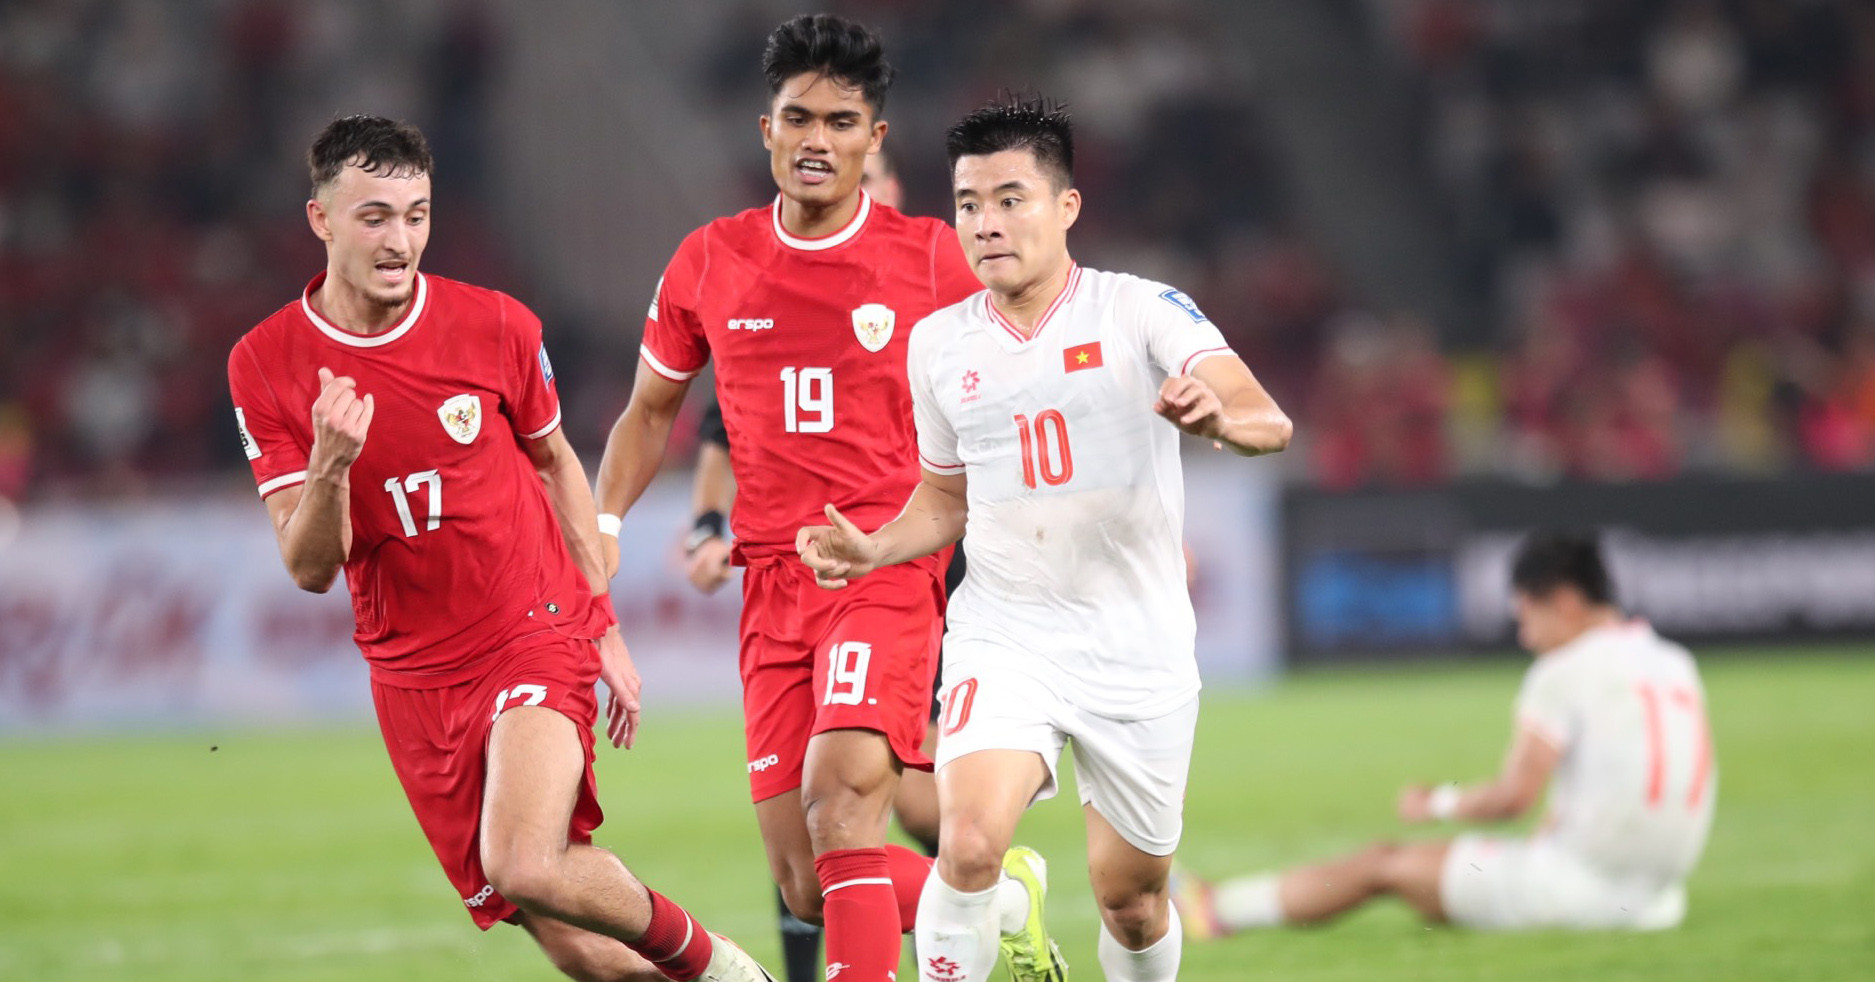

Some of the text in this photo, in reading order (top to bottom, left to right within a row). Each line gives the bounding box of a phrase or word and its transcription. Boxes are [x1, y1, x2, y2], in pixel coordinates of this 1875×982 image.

[727, 318, 774, 332] erspo
[780, 366, 834, 433] 19
[1013, 408, 1073, 489] 10
[384, 469, 442, 538] 17
[747, 754, 779, 773] rspo
[1637, 684, 1714, 812] 17
